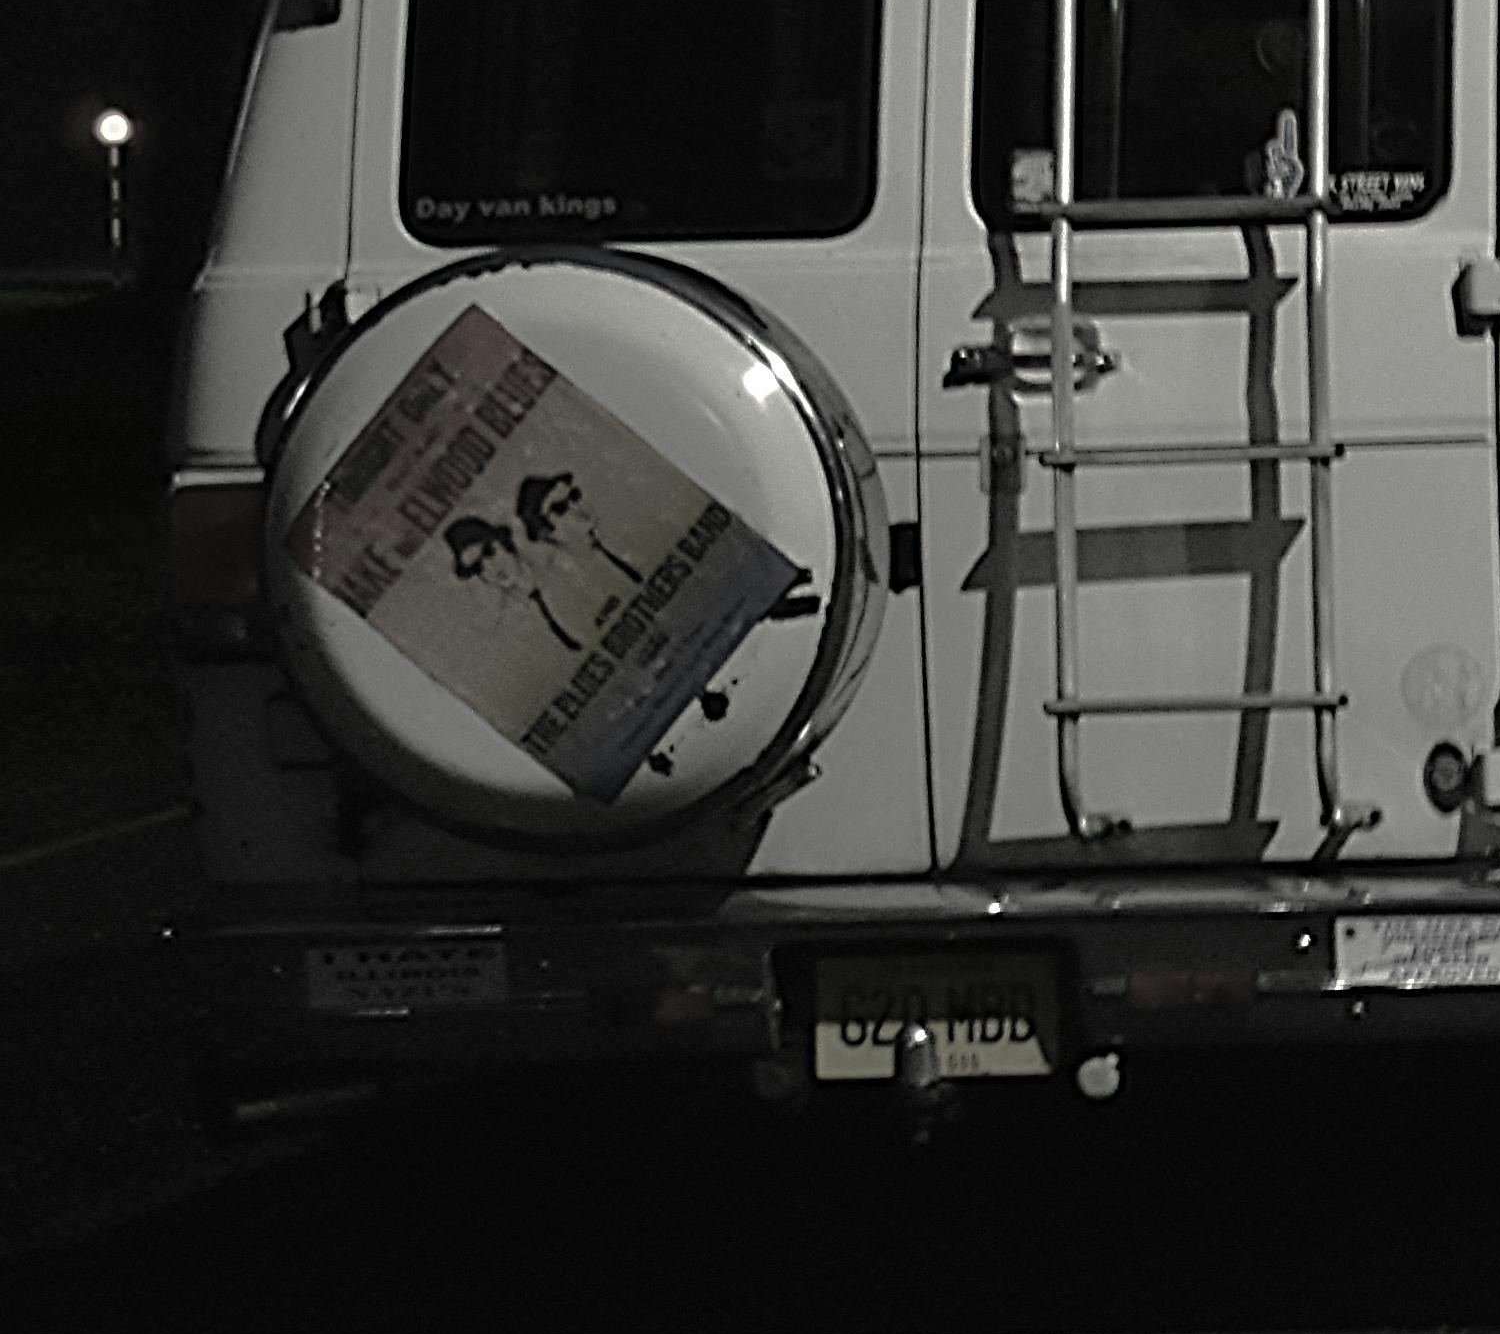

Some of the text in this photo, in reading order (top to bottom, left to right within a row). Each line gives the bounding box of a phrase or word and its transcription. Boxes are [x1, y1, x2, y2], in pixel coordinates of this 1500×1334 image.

[415, 193, 617, 224] Day van kings
[400, 425, 497, 539] ELWOOD
[474, 347, 559, 439] BLUES
[520, 710, 570, 755] THE
[553, 651, 614, 720] BLUES
[601, 552, 694, 659] BROTHERS
[676, 501, 732, 563] BAND
